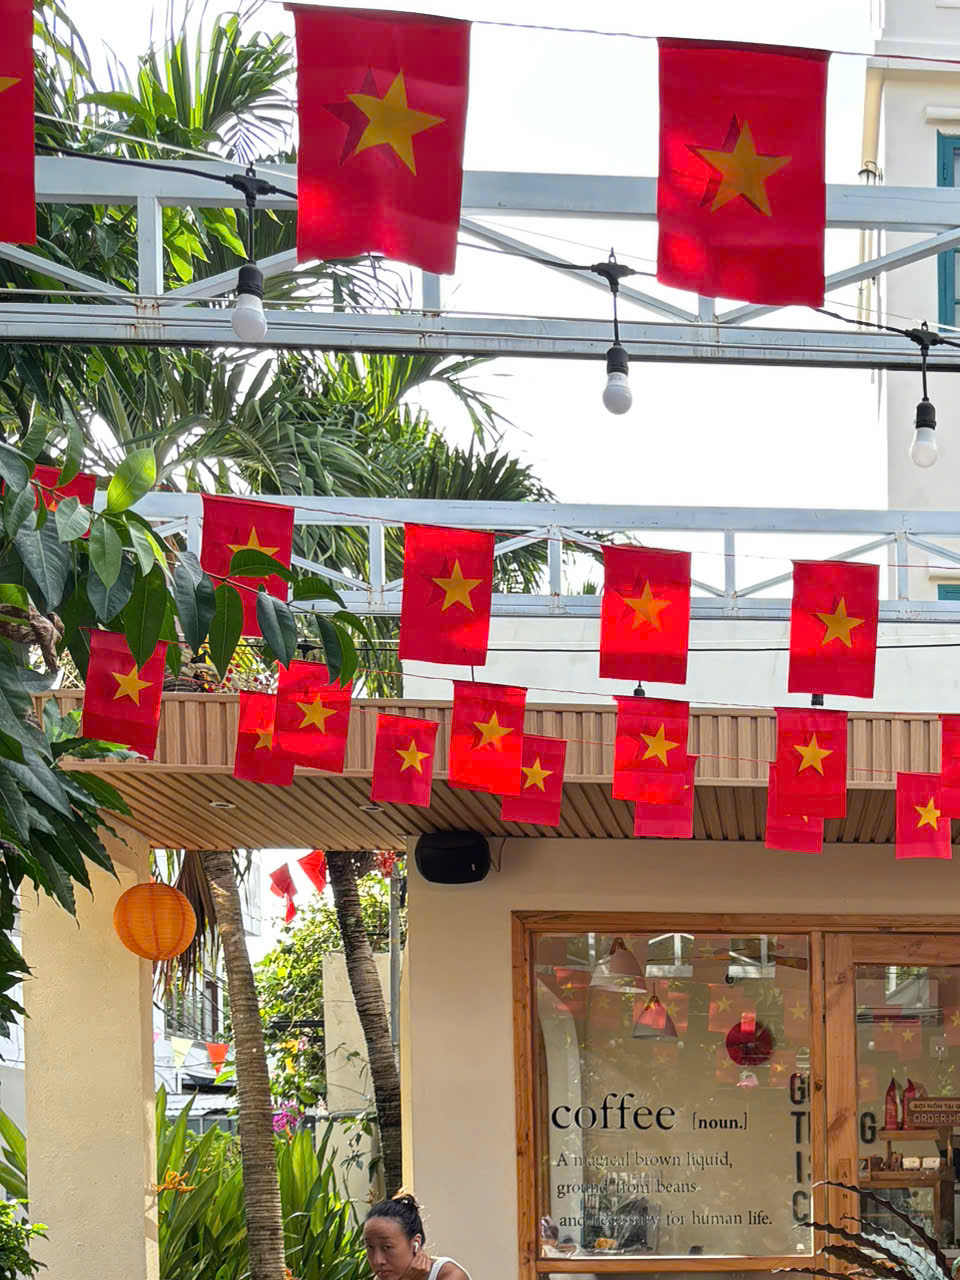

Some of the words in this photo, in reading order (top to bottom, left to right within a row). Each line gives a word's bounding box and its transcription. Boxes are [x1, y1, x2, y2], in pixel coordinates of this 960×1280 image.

[551, 1093, 676, 1130] coffee
[692, 1112, 748, 1130] [noun.]
[913, 1113, 945, 1122] ORDER
[556, 1152, 569, 1166] A
[573, 1152, 630, 1170] magical
[635, 1152, 681, 1166] brown
[687, 1151, 733, 1170] liquid,
[557, 1181, 610, 1198] ground
[615, 1181, 650, 1194] from
[655, 1181, 698, 1194] beans
[559, 1212, 586, 1227] and
[666, 1211, 685, 1225] for
[692, 1210, 742, 1225] human
[748, 1210, 773, 1225] life.
